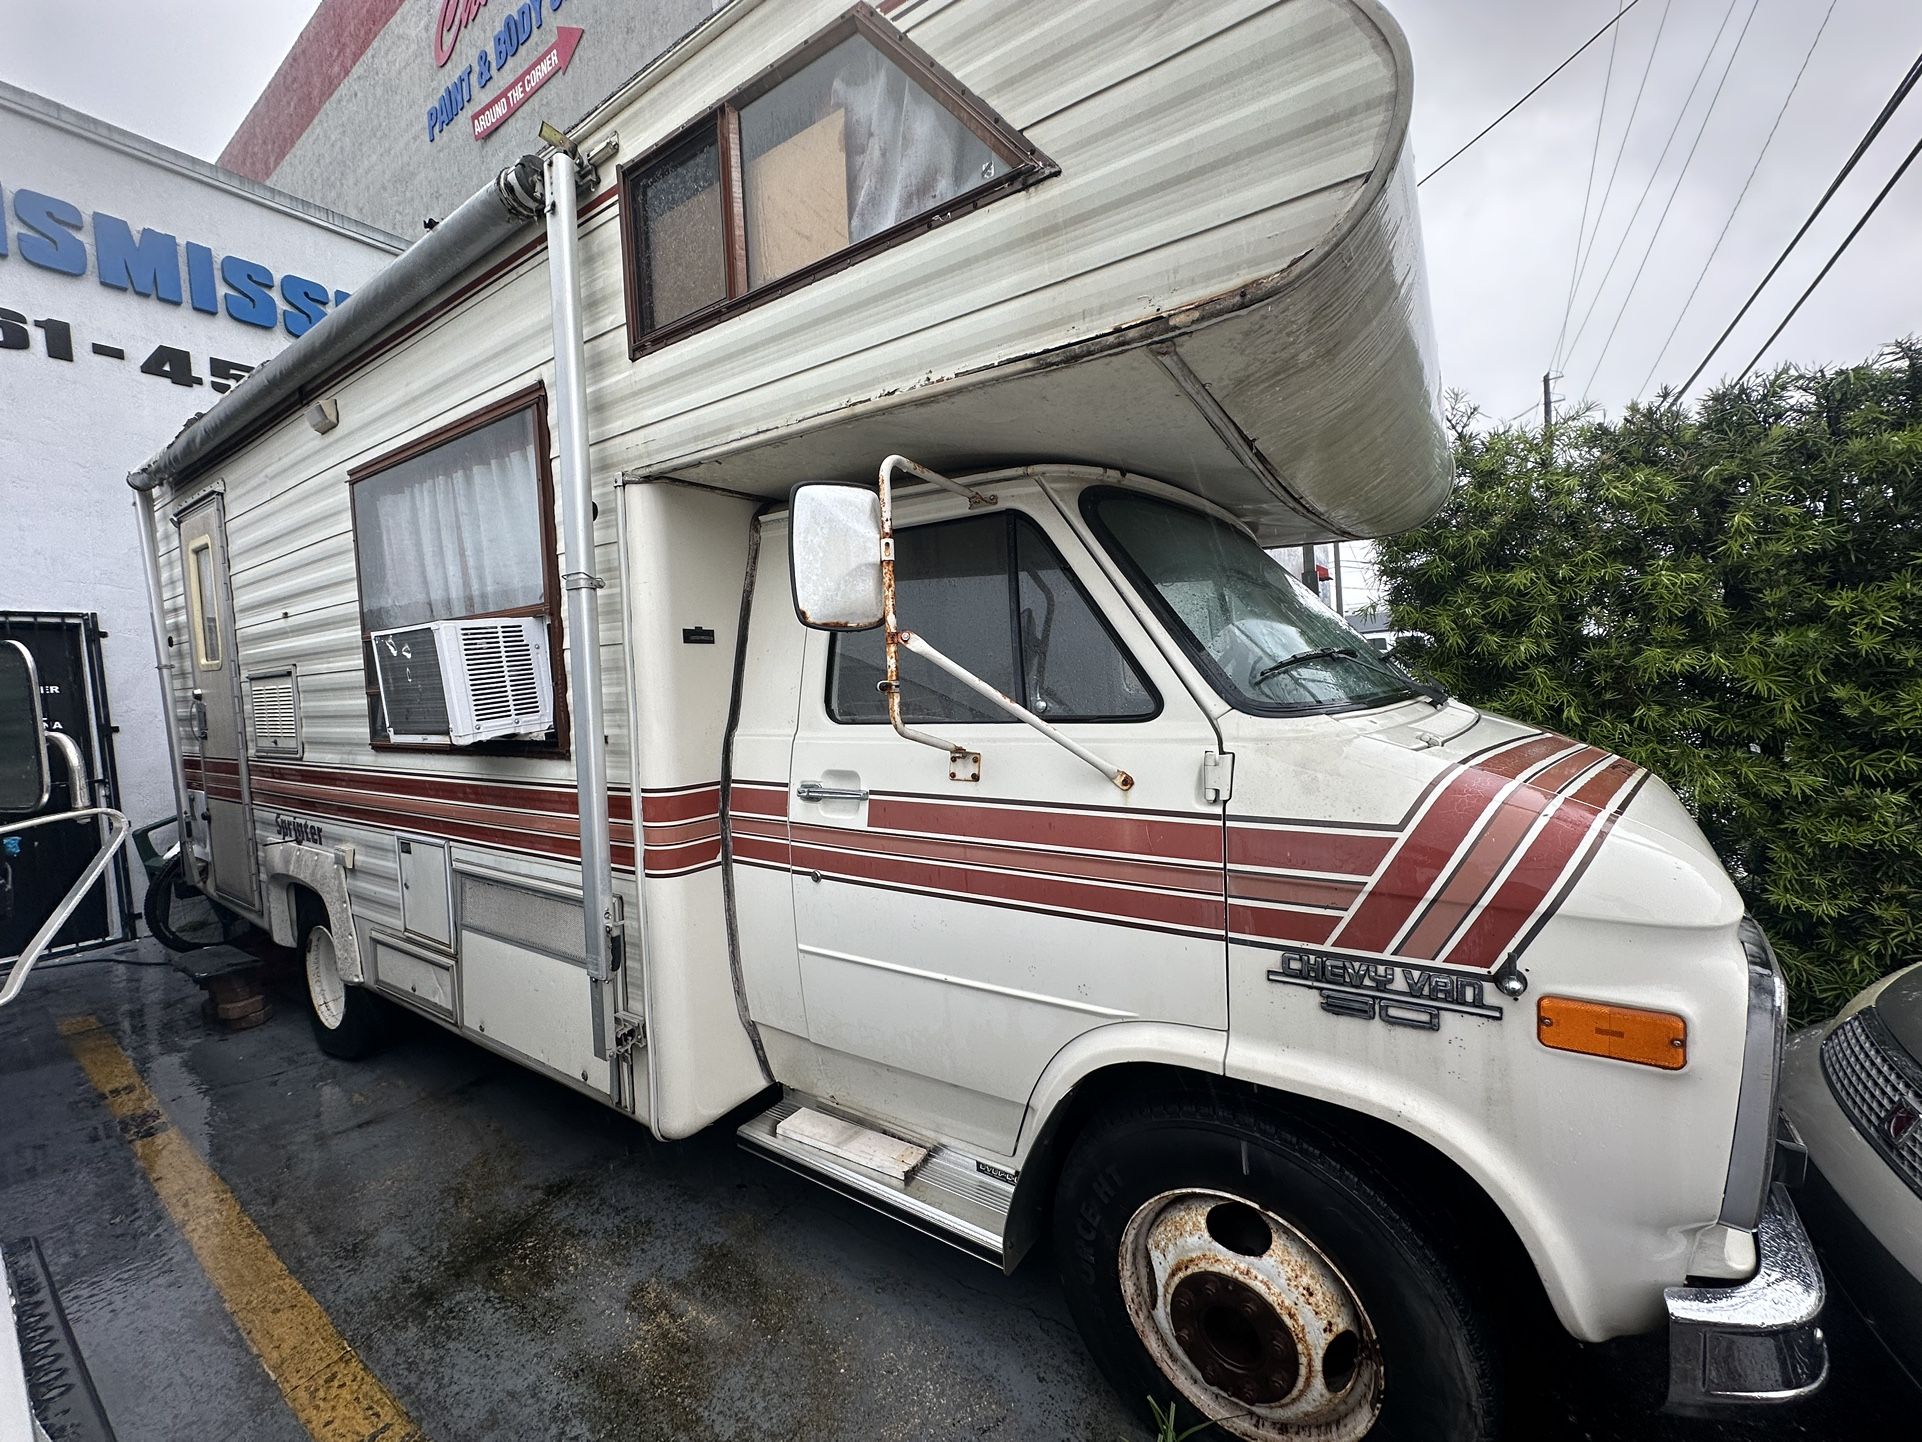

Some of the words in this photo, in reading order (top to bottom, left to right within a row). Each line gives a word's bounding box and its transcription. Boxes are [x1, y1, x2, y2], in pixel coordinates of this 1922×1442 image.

[426, 64, 472, 142] PAINT
[477, 49, 493, 88] &
[492, 0, 543, 71] BODY
[474, 99, 508, 135] AROUND
[507, 82, 525, 107] THE
[524, 48, 559, 92] CORNER
[0, 182, 352, 338] SMISS
[1281, 952, 1395, 991] CHEVY
[1401, 968, 1484, 1007] VAN
[1319, 989, 1440, 1032] 30
